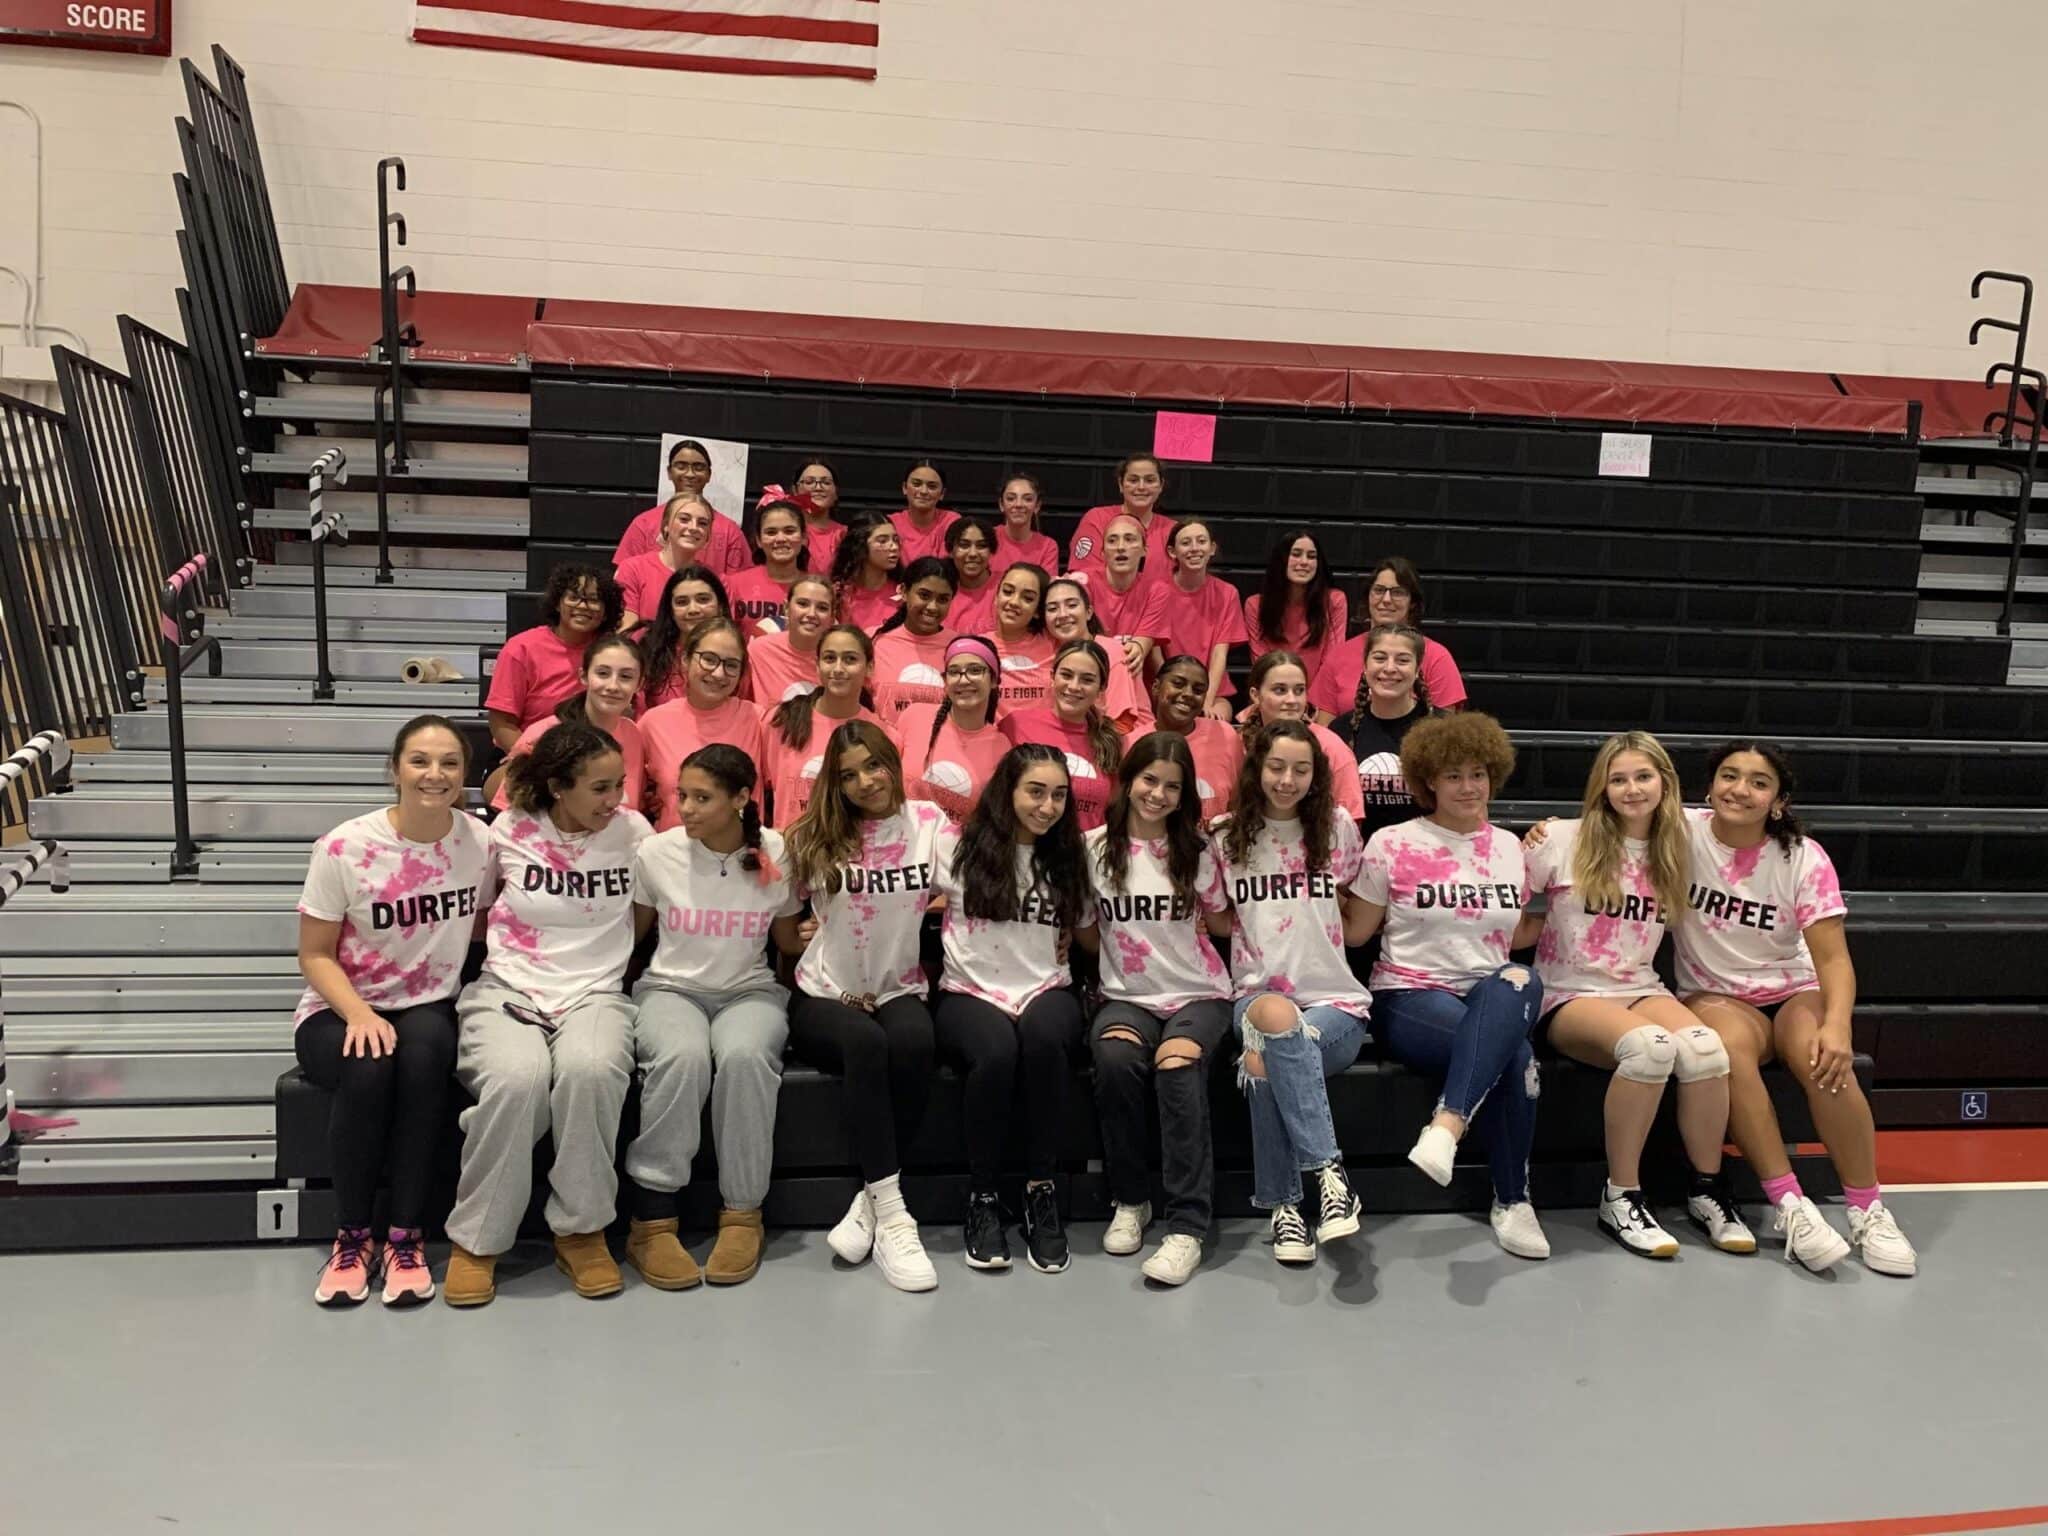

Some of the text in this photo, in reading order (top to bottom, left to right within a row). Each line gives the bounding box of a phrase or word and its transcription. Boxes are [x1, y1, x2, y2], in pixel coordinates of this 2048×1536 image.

[66, 3, 146, 32] SCORE
[734, 599, 784, 619] DUR
[1013, 687, 1044, 699] FIGHT
[1376, 794, 1413, 806] FIGHT
[1235, 871, 1334, 905] DURFEE
[1100, 894, 1193, 922] DURFE
[1687, 883, 1777, 931] URFEE
[667, 905, 771, 938] DURFEE
